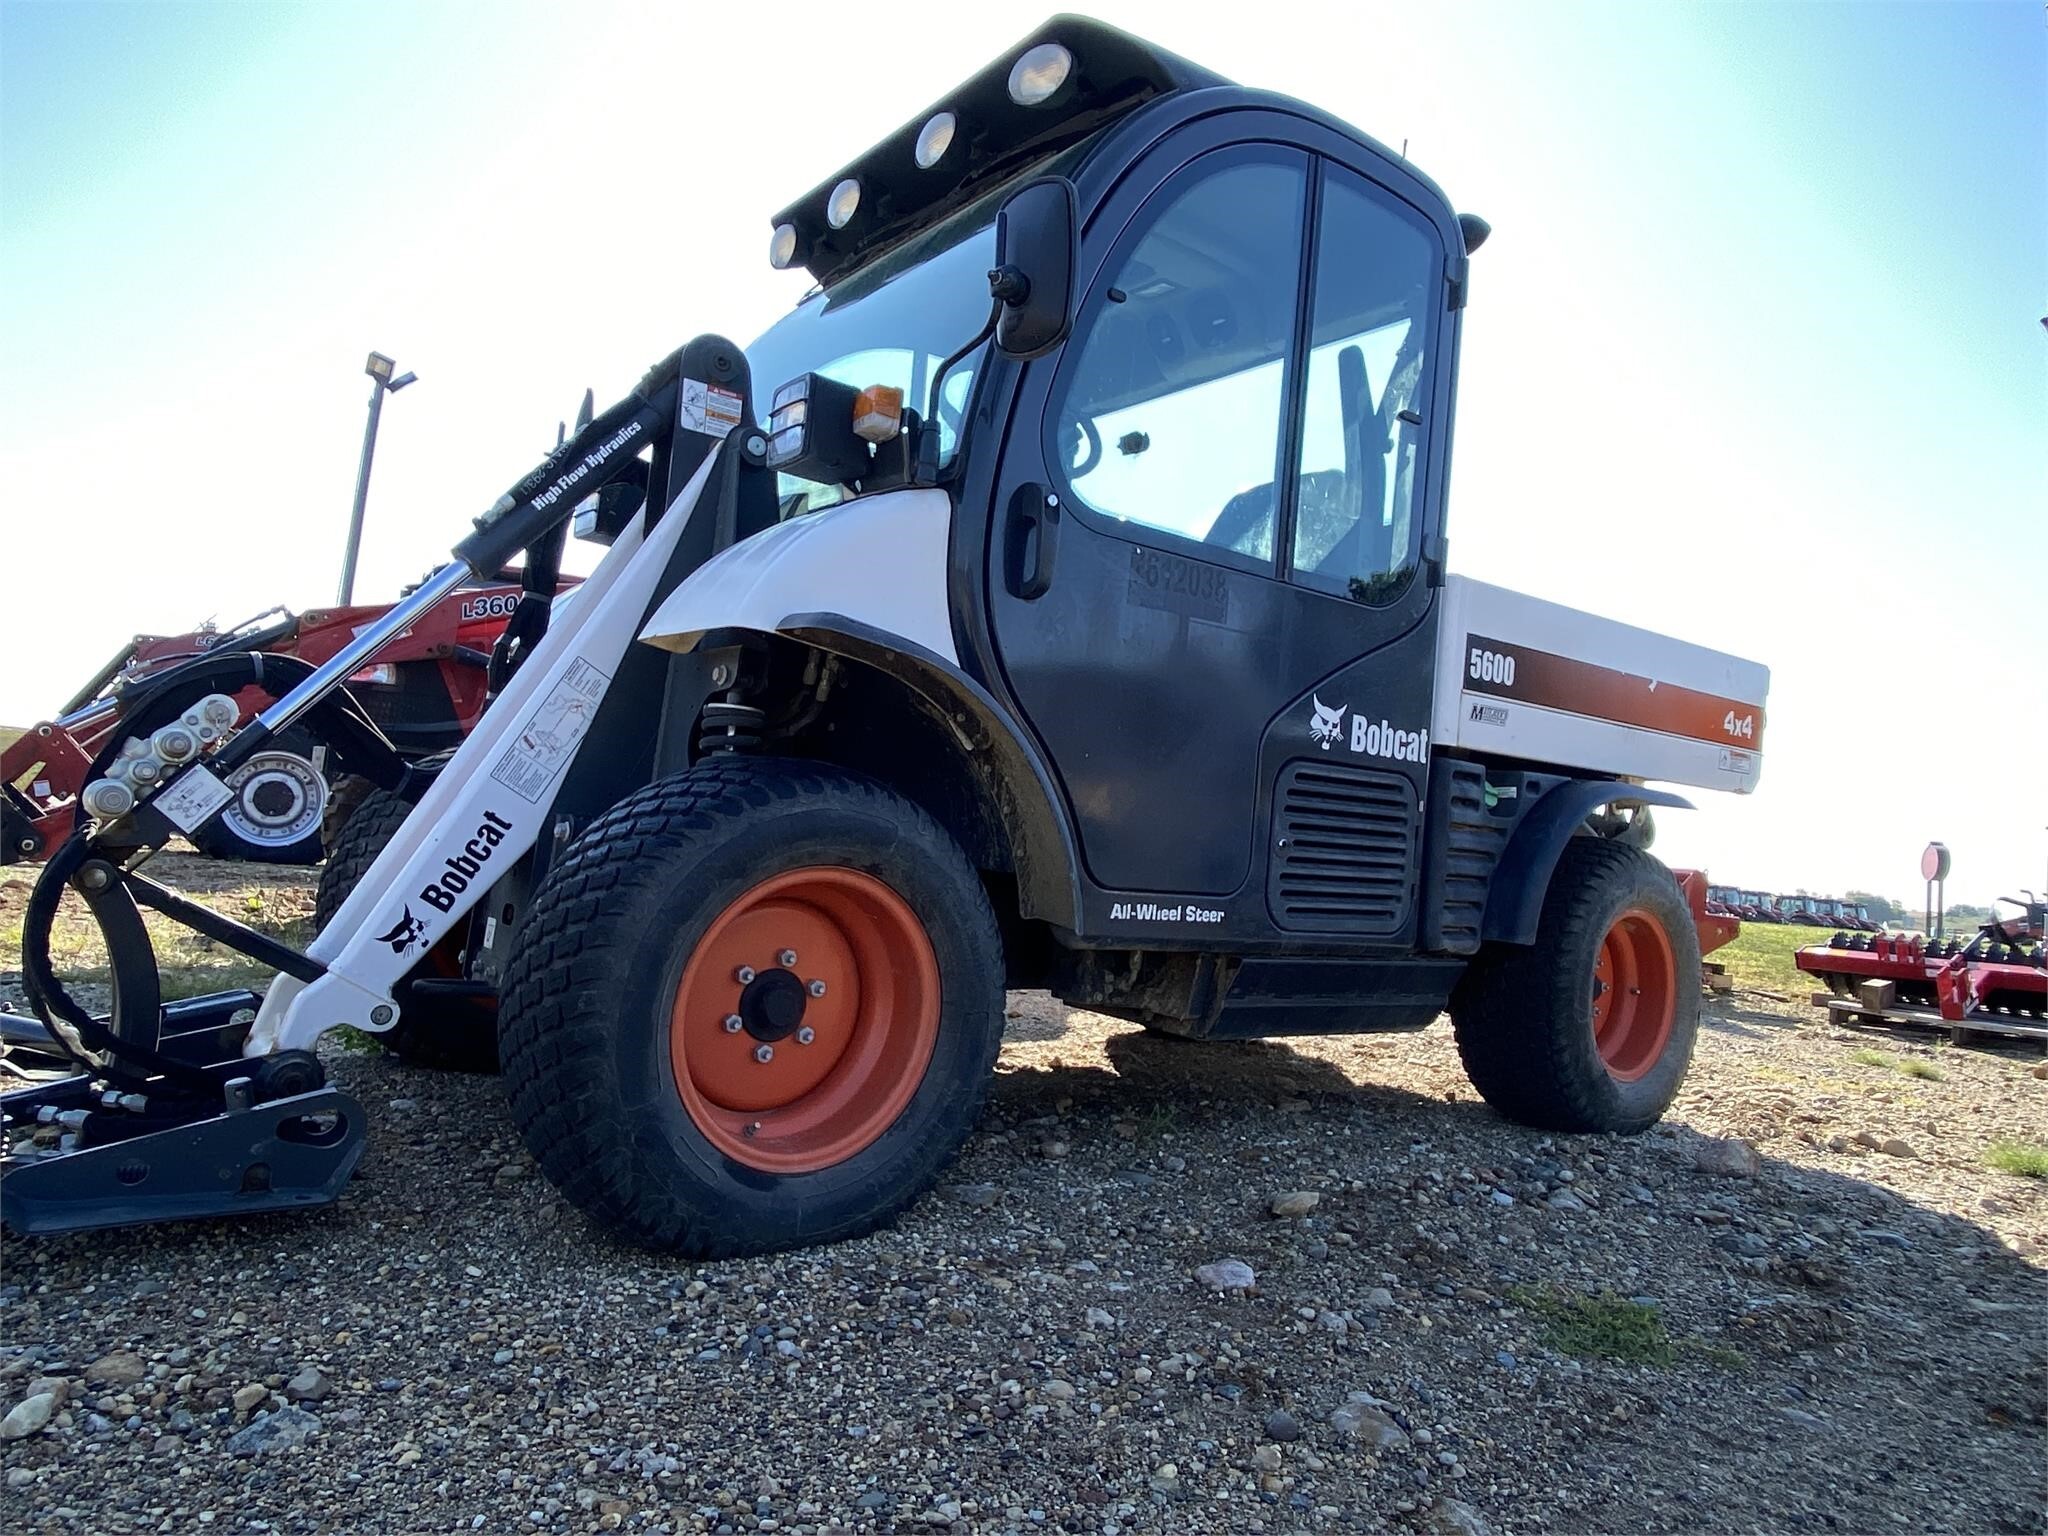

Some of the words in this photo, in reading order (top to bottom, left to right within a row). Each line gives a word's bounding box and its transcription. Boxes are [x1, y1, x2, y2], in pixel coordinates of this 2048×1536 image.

[530, 485, 563, 511] High
[557, 463, 588, 490] Flow
[584, 421, 642, 468] Hydraulics
[462, 594, 520, 620] L360
[1470, 648, 1515, 687] 5600
[1350, 713, 1428, 764] Bobcat
[1723, 710, 1752, 739] 4x4
[419, 810, 513, 914] Bobcat
[1110, 903, 1182, 921] All-Wheel
[1185, 905, 1225, 922] Steer
